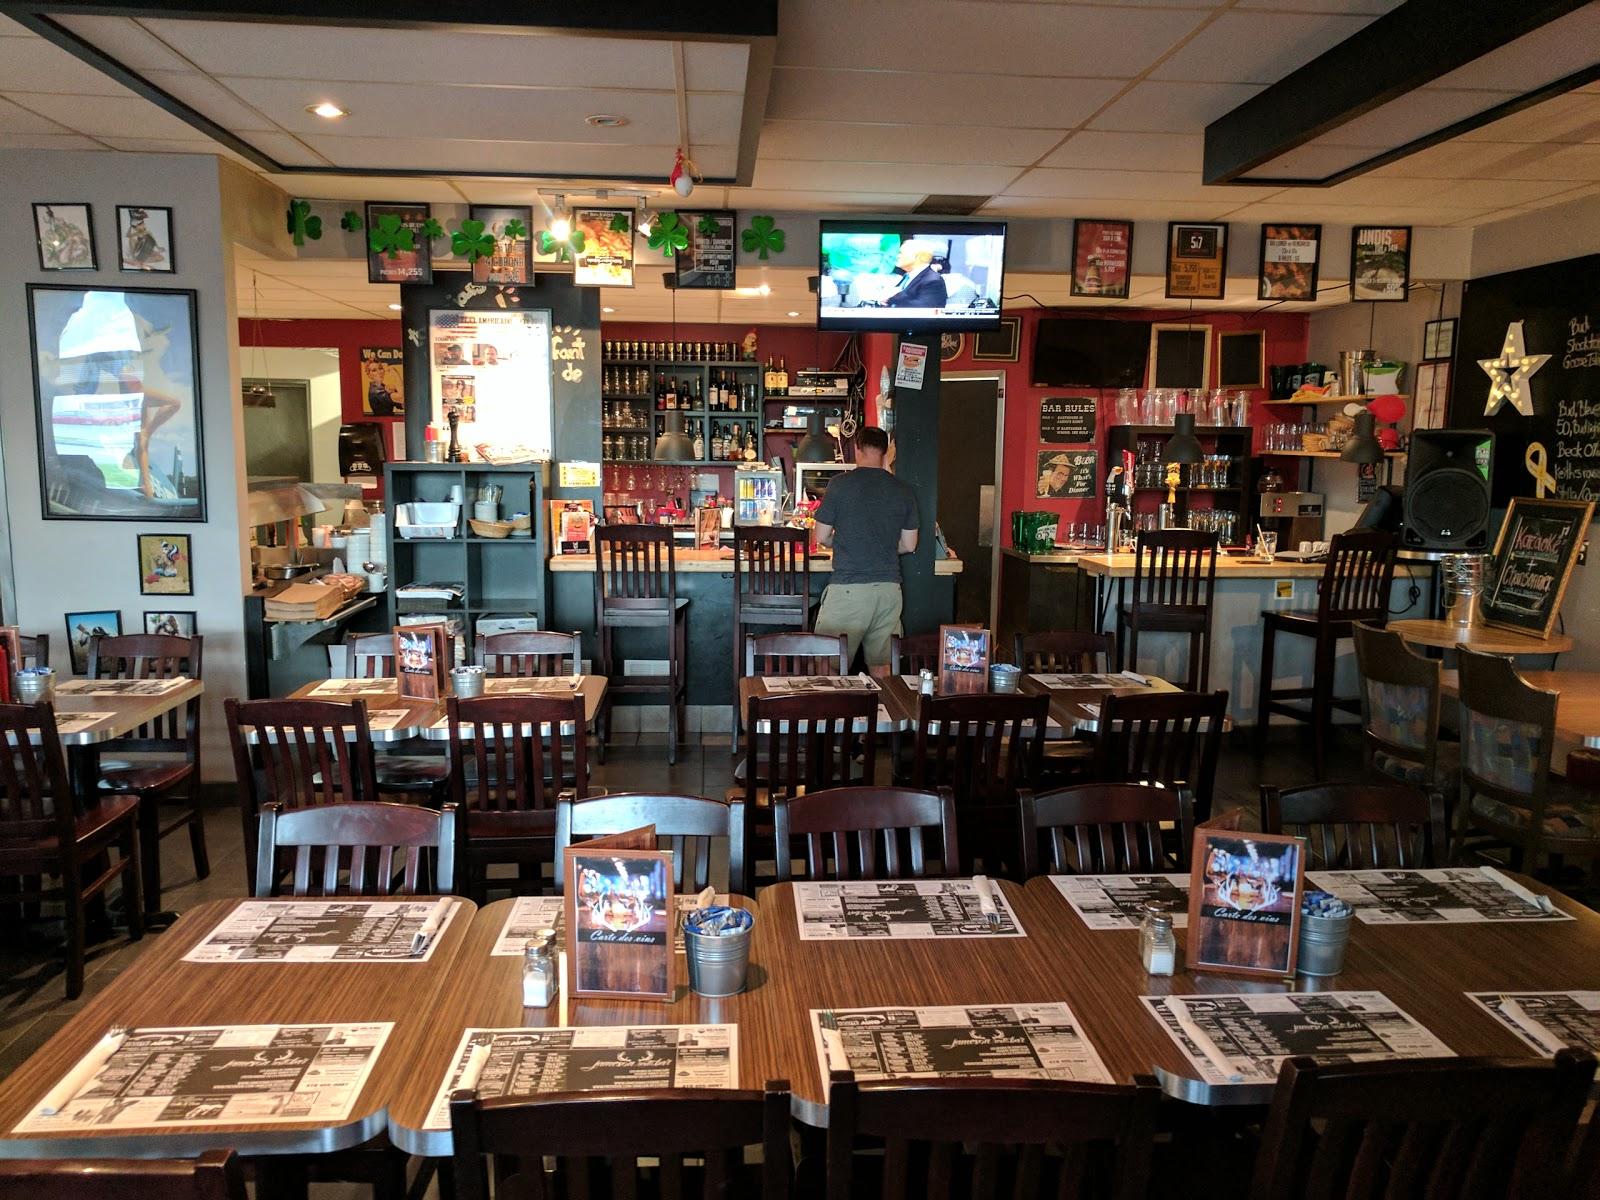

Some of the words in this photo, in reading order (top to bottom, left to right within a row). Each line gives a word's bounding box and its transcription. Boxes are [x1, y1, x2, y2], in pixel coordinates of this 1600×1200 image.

[362, 349, 376, 359] We
[377, 349, 392, 359] Can
[1042, 404, 1062, 413] BAR
[1064, 404, 1095, 413] RULES
[1213, 907, 1241, 919] Carte
[1242, 911, 1257, 921] des
[1259, 914, 1280, 923] vins
[590, 930, 616, 941] Carte
[617, 932, 633, 942] des
[634, 934, 656, 944] vins
